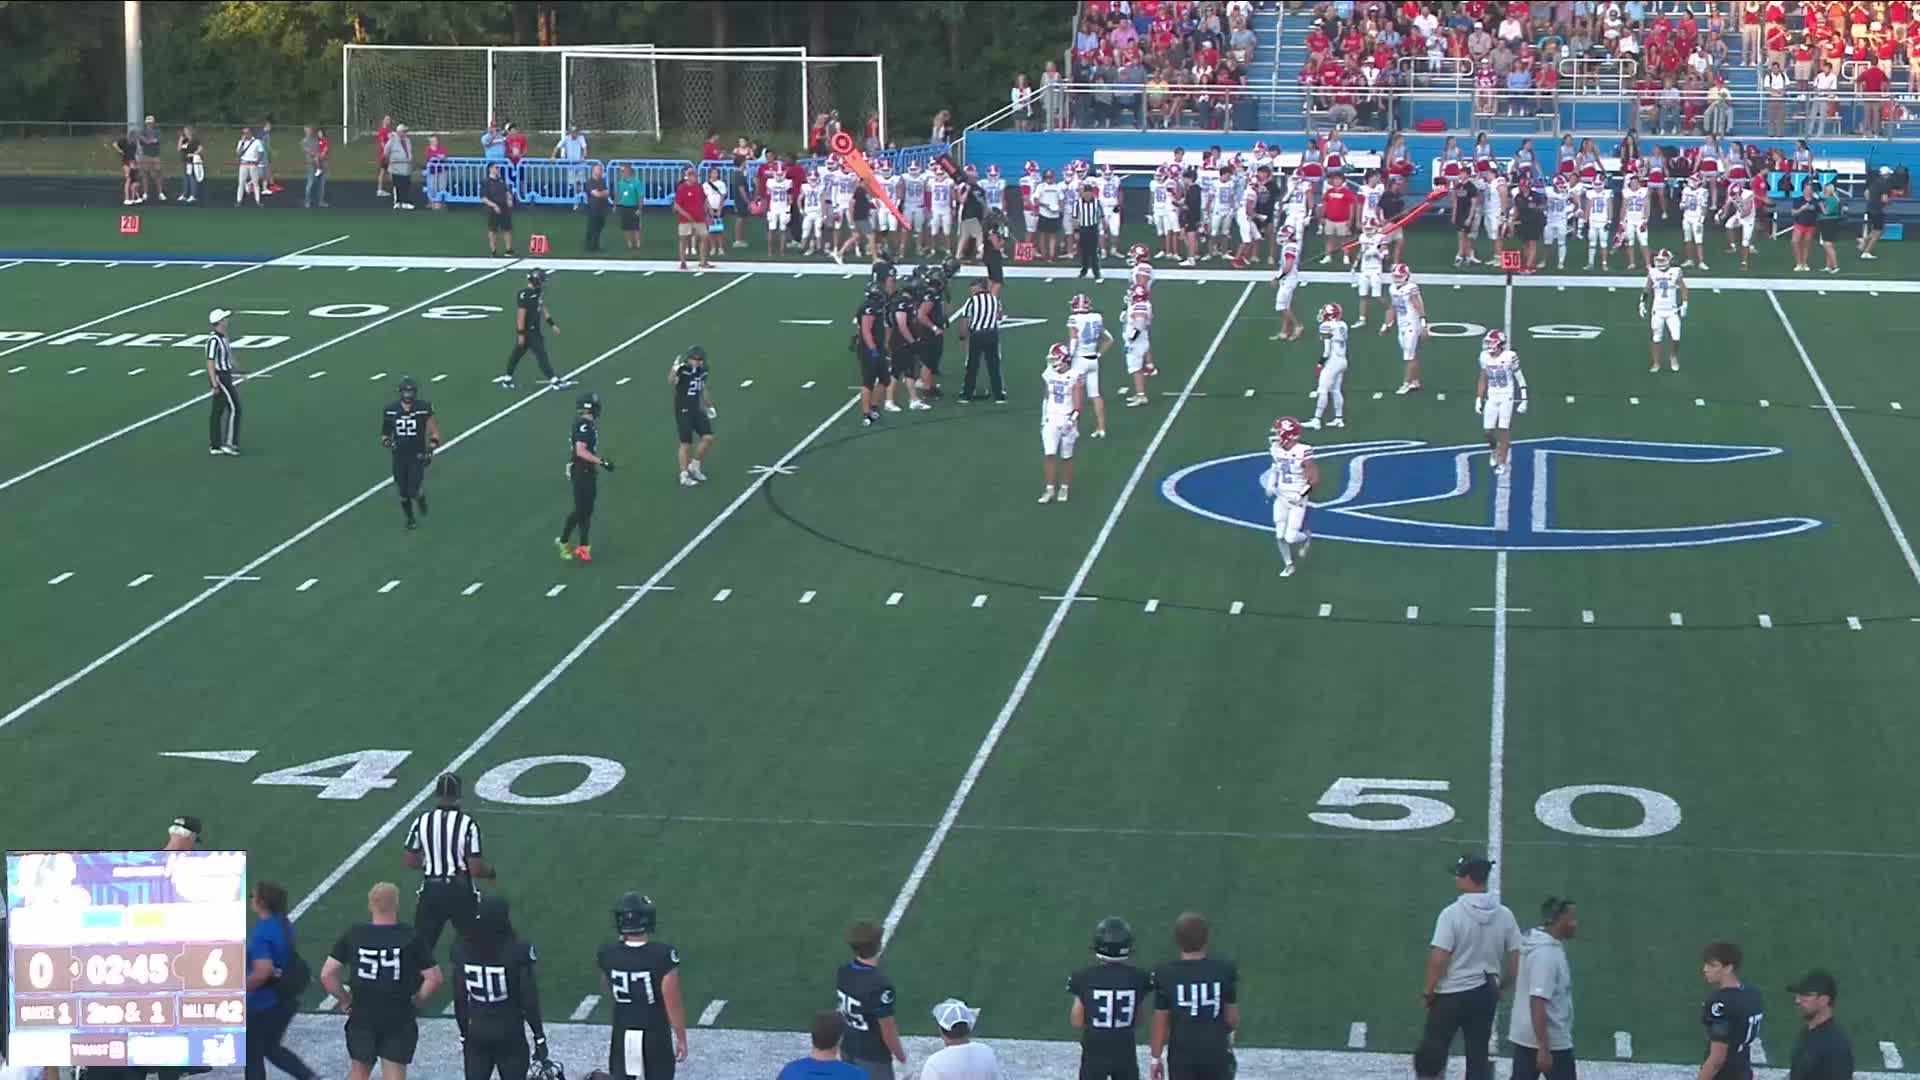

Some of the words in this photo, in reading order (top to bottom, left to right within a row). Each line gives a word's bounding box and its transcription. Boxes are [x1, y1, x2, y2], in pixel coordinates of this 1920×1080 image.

[1503, 251, 1520, 267] 50
[47, 331, 292, 349] FIELD
[395, 419, 417, 436] 22
[357, 947, 402, 981] 54
[463, 964, 509, 1003] 20
[609, 969, 658, 1005] 27
[1175, 982, 1222, 1018] 44
[1092, 988, 1137, 1029] 33
